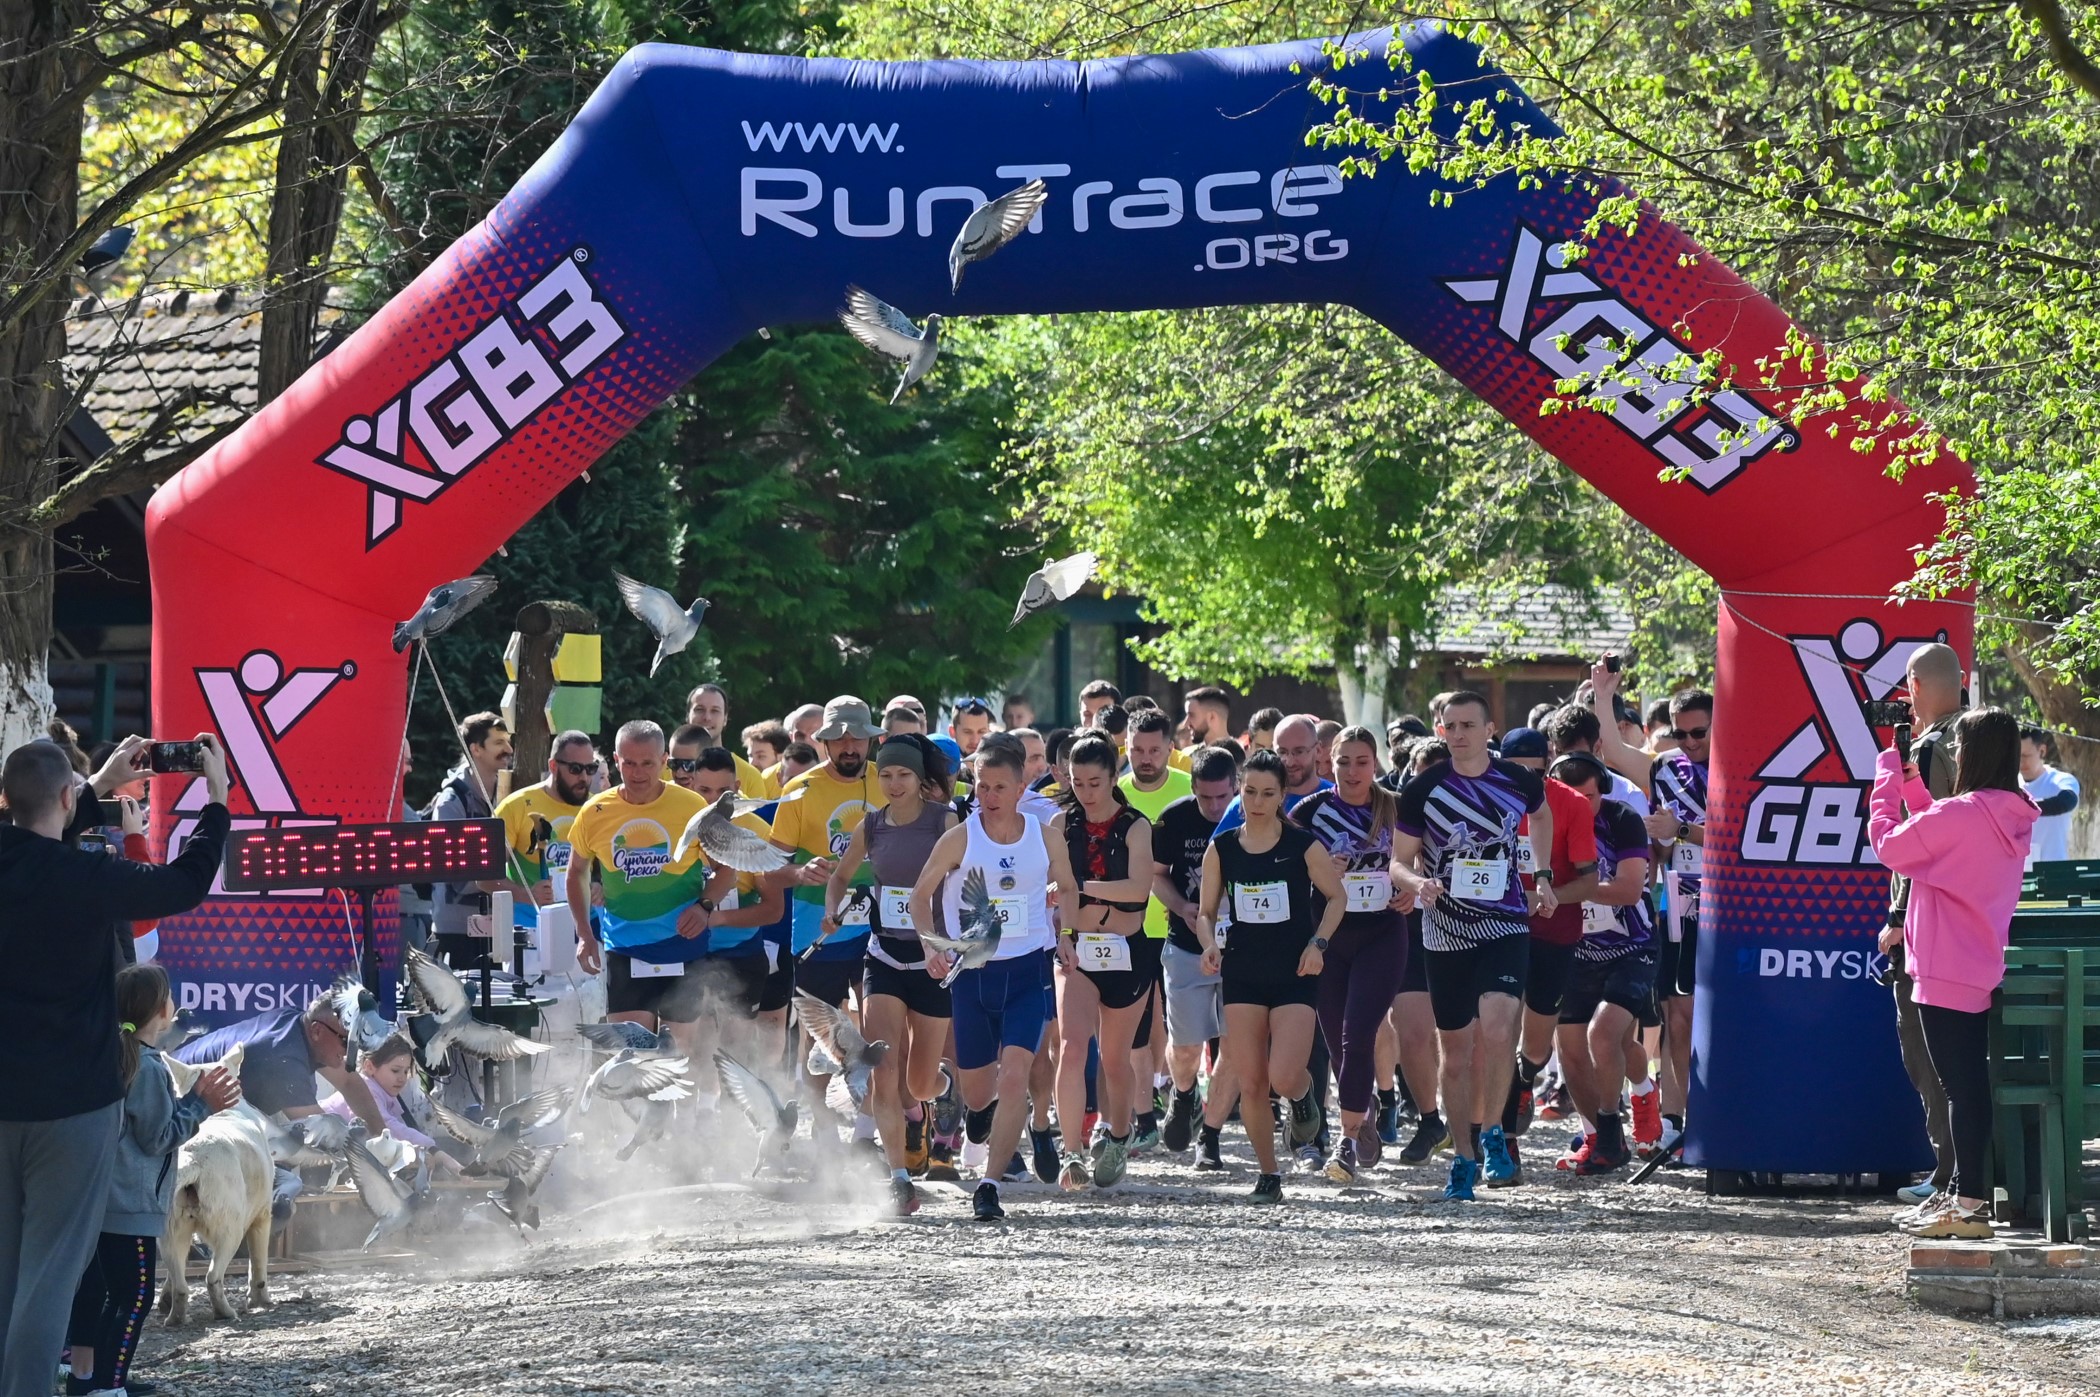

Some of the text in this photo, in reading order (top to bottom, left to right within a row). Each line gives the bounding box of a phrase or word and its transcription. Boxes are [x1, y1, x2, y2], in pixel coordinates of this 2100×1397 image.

[741, 163, 1344, 237] RunTrace
[1193, 229, 1349, 271] .ORG
[1740, 784, 1879, 863] GB
[1680, 849, 1693, 861] 13
[1471, 872, 1490, 886] 26
[1358, 885, 1374, 898] 17
[1252, 897, 1270, 909] 74
[1094, 946, 1112, 958] 32
[1758, 948, 1884, 980] DRYSK
